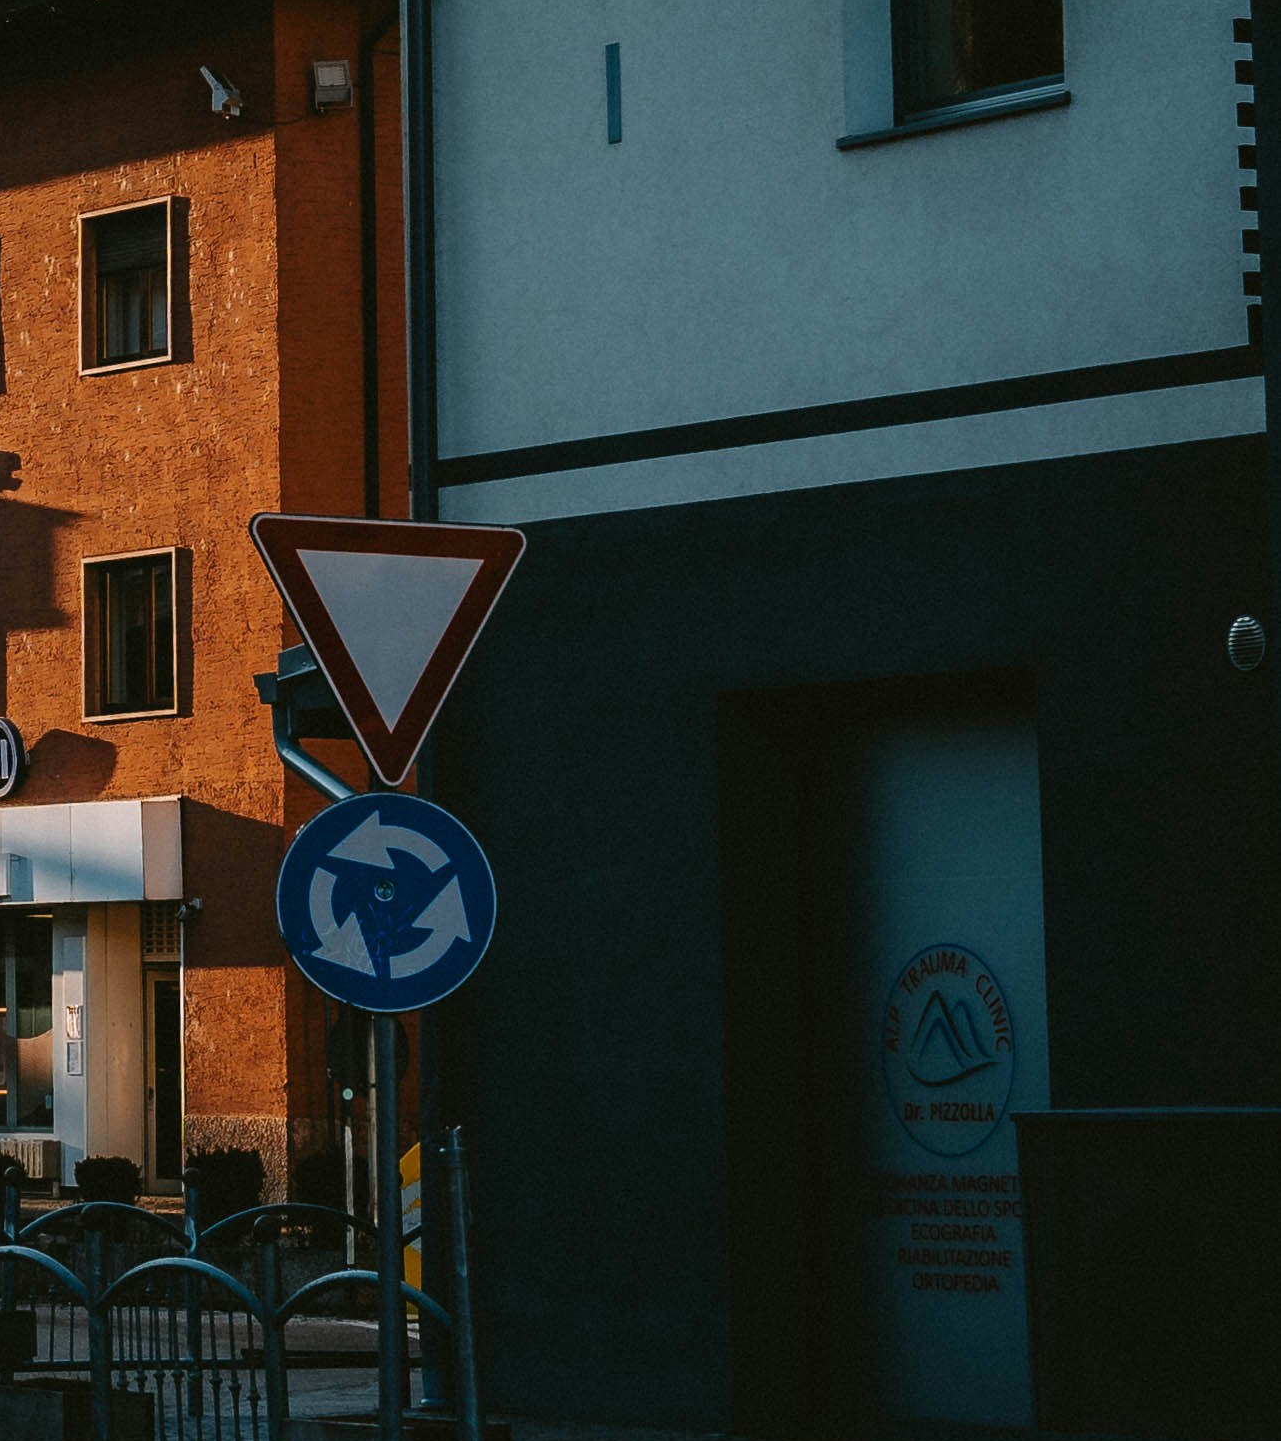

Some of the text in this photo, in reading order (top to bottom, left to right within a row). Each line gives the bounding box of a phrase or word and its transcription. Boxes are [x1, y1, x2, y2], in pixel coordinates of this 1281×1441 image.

[884, 950, 1012, 1054] ALP TRAUMA CLINIC
[904, 1102, 995, 1121] Dr. PIZZOLLA
[911, 1223, 997, 1241] ECOGRAFIA
[897, 1248, 1012, 1267] RIABILITAZIONE
[912, 1272, 1000, 1292] ORTOPEDIA
